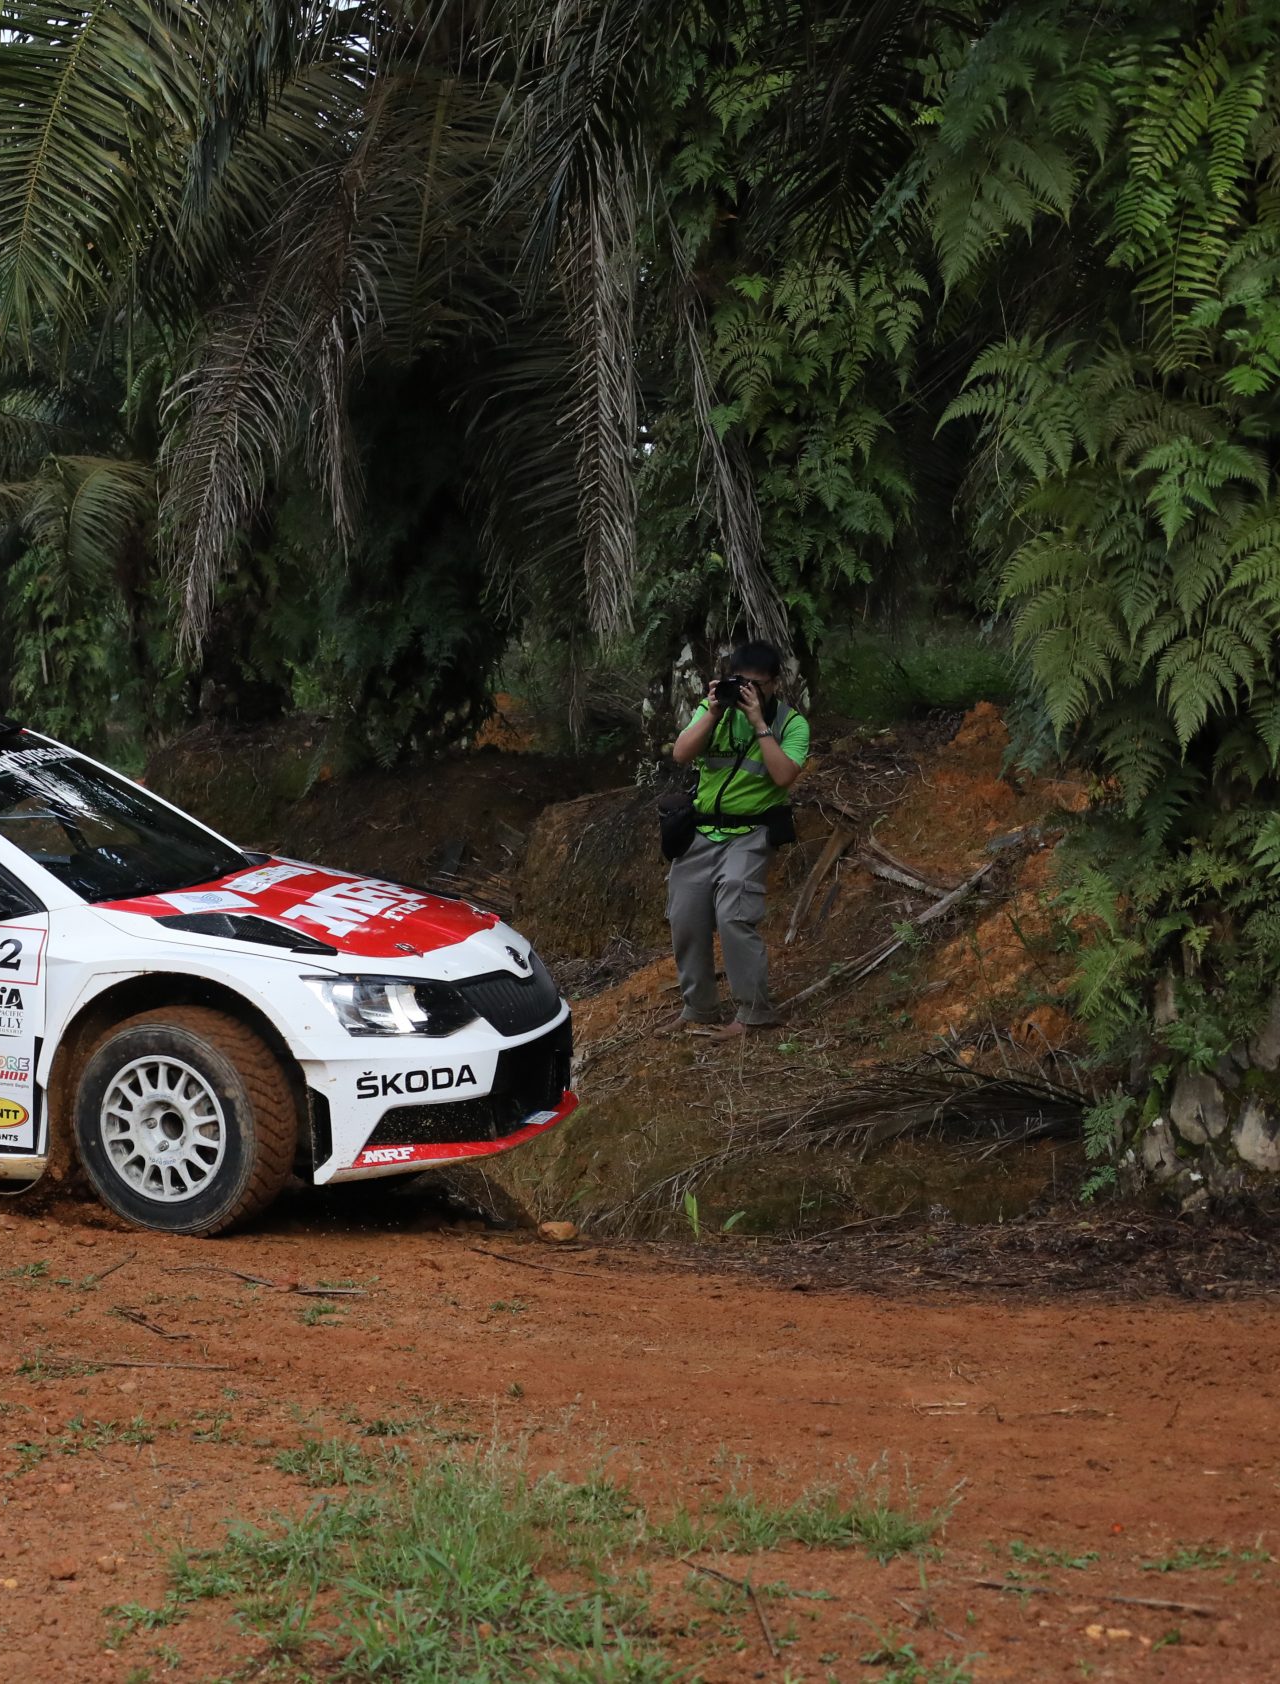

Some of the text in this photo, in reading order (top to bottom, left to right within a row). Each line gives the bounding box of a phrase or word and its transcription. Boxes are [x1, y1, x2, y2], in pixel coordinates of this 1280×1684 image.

[279, 879, 429, 938] MRF
[356, 1064, 477, 1100] ŠKODA
[362, 1146, 416, 1164] MRF
